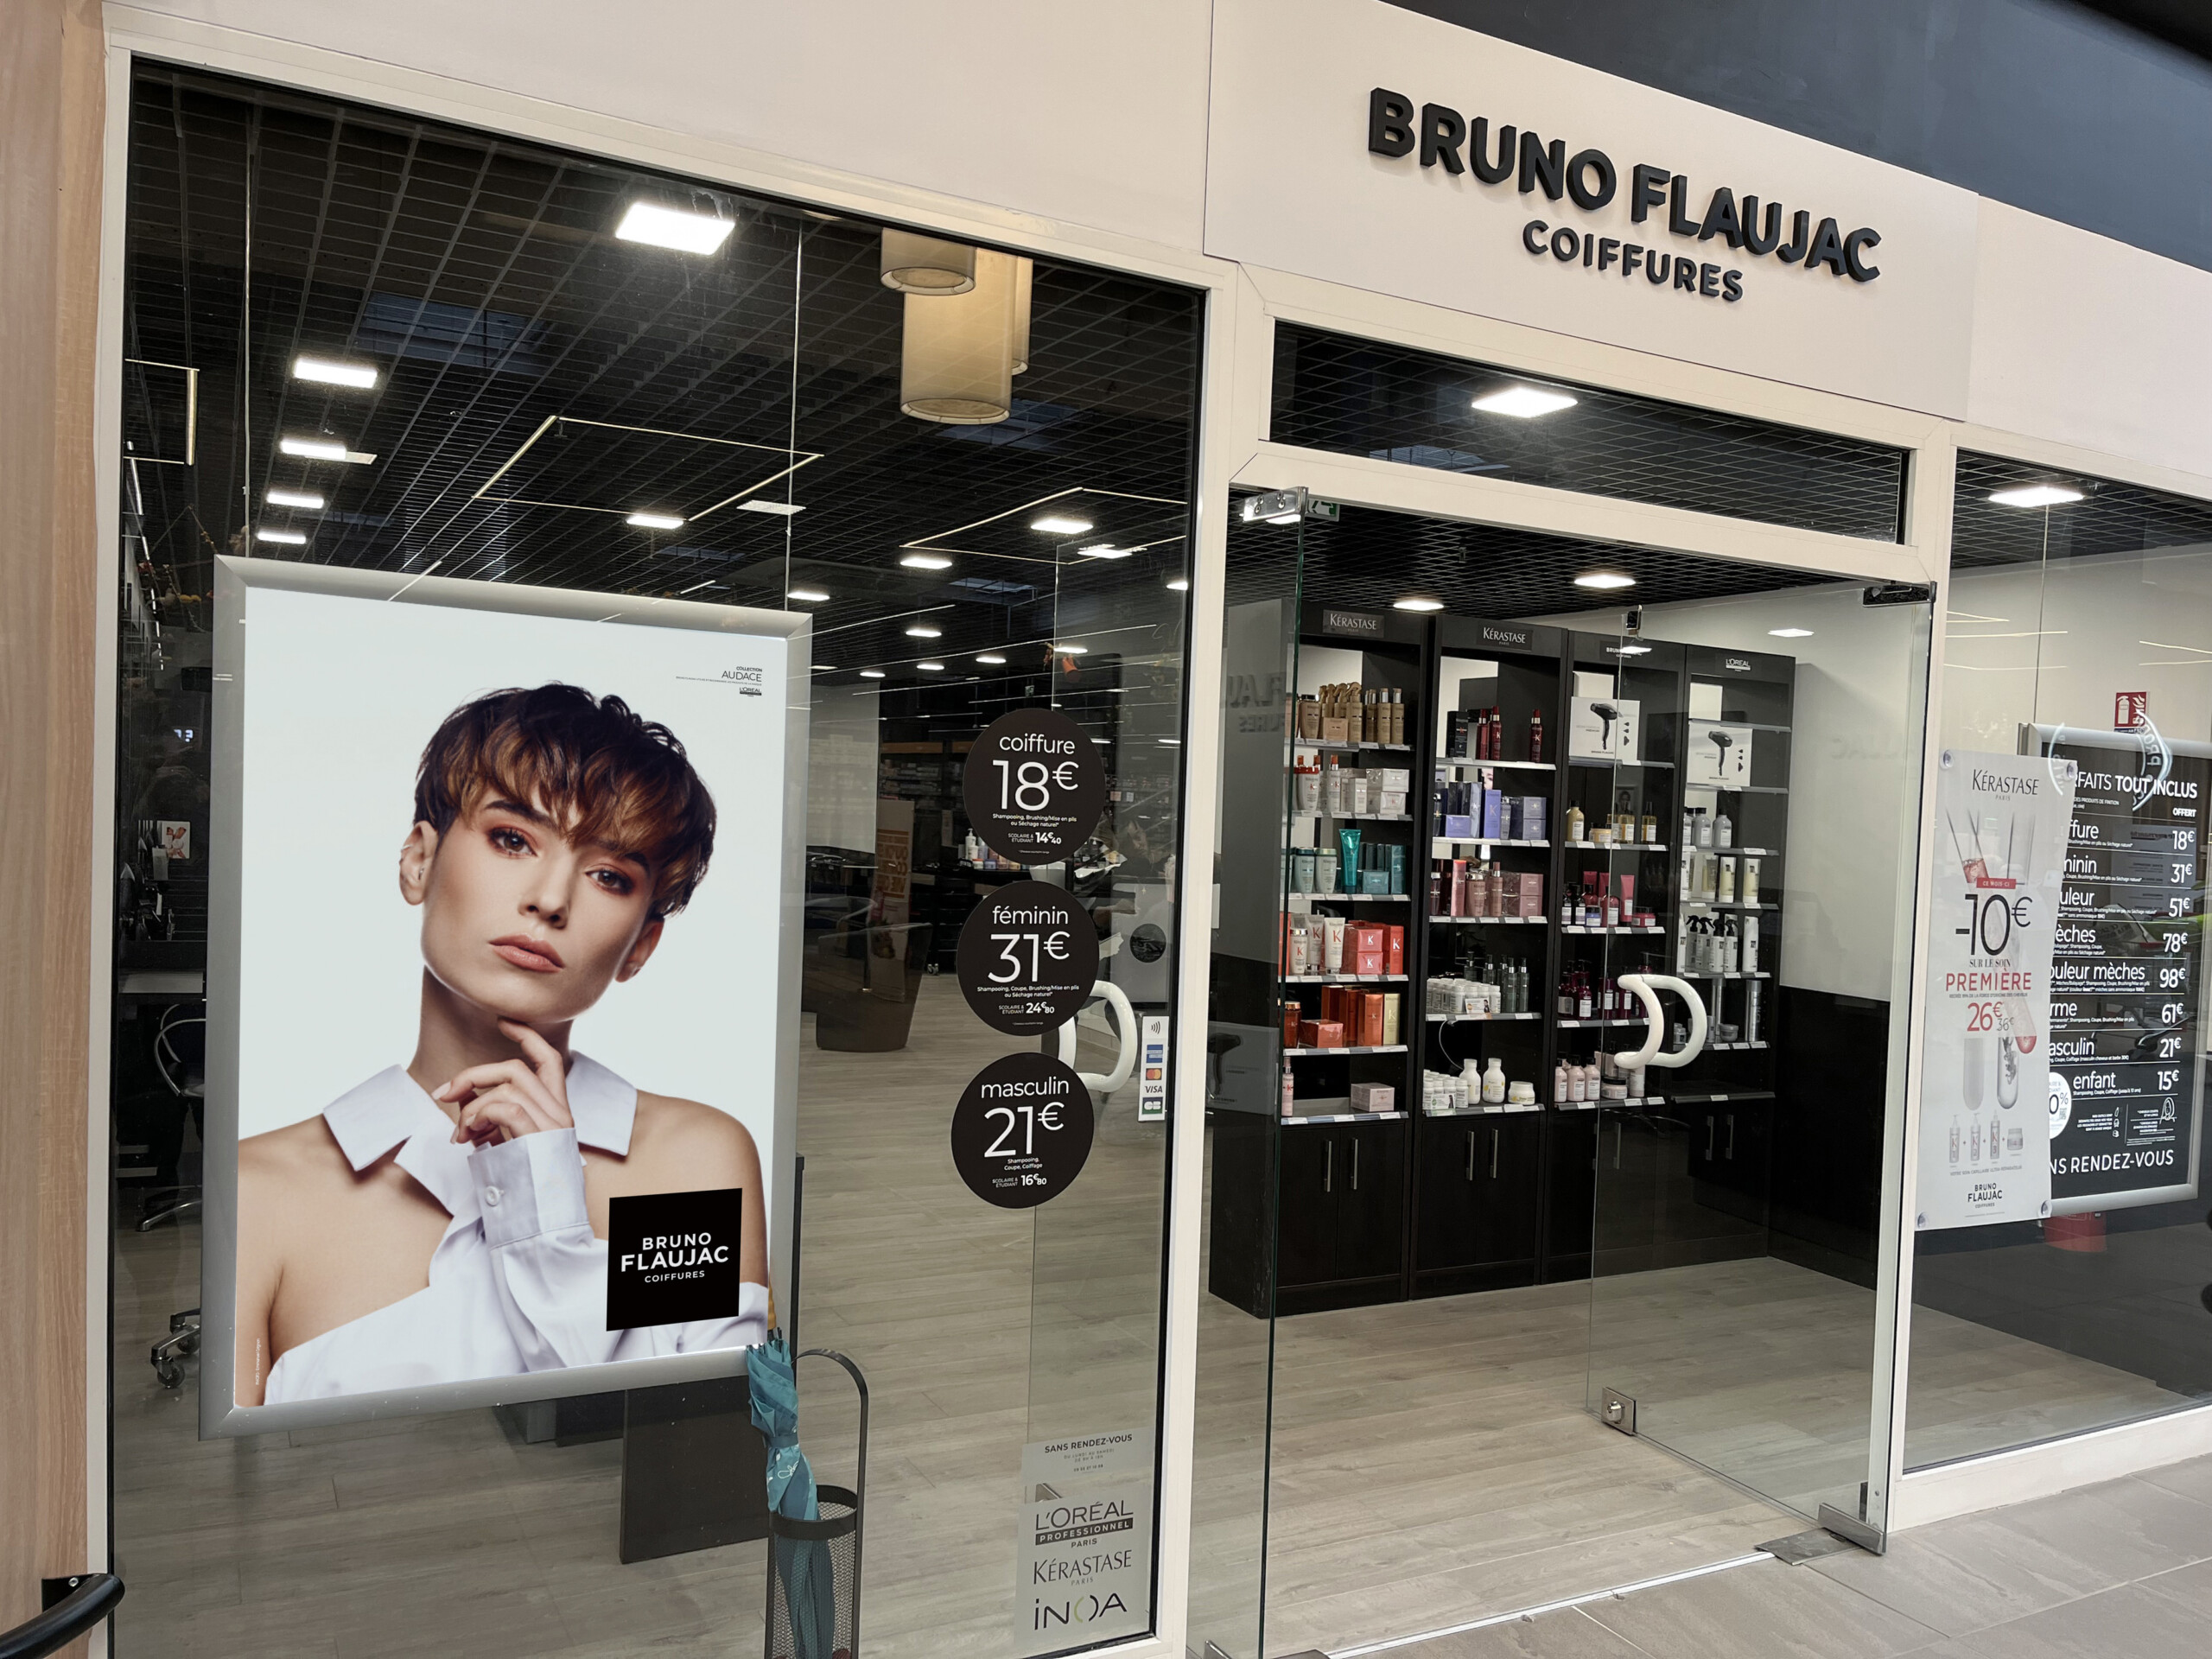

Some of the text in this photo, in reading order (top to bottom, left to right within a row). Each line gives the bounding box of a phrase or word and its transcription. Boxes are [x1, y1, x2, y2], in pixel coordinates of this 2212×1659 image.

[1369, 87, 1881, 283] BRUNO FLAUJAC
[1522, 219, 1743, 302] COIFFURES
[1330, 613, 1376, 630] KÉRASTASE
[1483, 626, 1526, 643] KÉRASTASE
[721, 671, 762, 682] AUDACE
[999, 733, 1076, 754] coiffure
[993, 760, 1079, 810] 18€
[1972, 768, 2039, 796] KÉRASTASE
[2114, 775, 2151, 794] TOUT
[2153, 779, 2197, 799] INCLUS
[2172, 807, 2196, 817] OFFERT
[2172, 830, 2195, 850] 18€
[2171, 863, 2192, 883] 31€
[992, 906, 1068, 925] féminin
[2168, 897, 2190, 917] 51€
[2163, 932, 2188, 953] 78€
[988, 931, 1071, 983] 31€
[1946, 968, 2031, 991] PREMIÈRE
[2094, 962, 2145, 980] mèches
[2160, 968, 2186, 988] 98€
[1967, 1001, 2003, 1031] 26€
[2162, 1003, 2183, 1023] 61€
[1996, 1017, 2014, 1031] 36€
[2159, 1037, 2182, 1058] 21€
[981, 1077, 1069, 1098] masculin
[2073, 1071, 2116, 1090] enfant
[2158, 1070, 2179, 1090] 15€
[983, 1102, 1065, 1158] 21€
[2070, 1149, 2174, 1173] RENDEZ-VOUS
[1967, 1190, 2003, 1202] FLAUJAC
[1974, 1183, 1997, 1192] BRUNO
[642, 1232, 711, 1250] BRUNO
[621, 1246, 729, 1272] FLAUJAC
[645, 1270, 705, 1283] COIFFURES
[1045, 1433, 1132, 1453] SANS RENDEZ-VOUS
[1036, 1500, 1134, 1530] L'ORÉAL
[1039, 1521, 1129, 1542] PROFESSIONNEL
[1071, 1538, 1097, 1548] PARIS
[1033, 1549, 1132, 1585] KÉRASTASE
